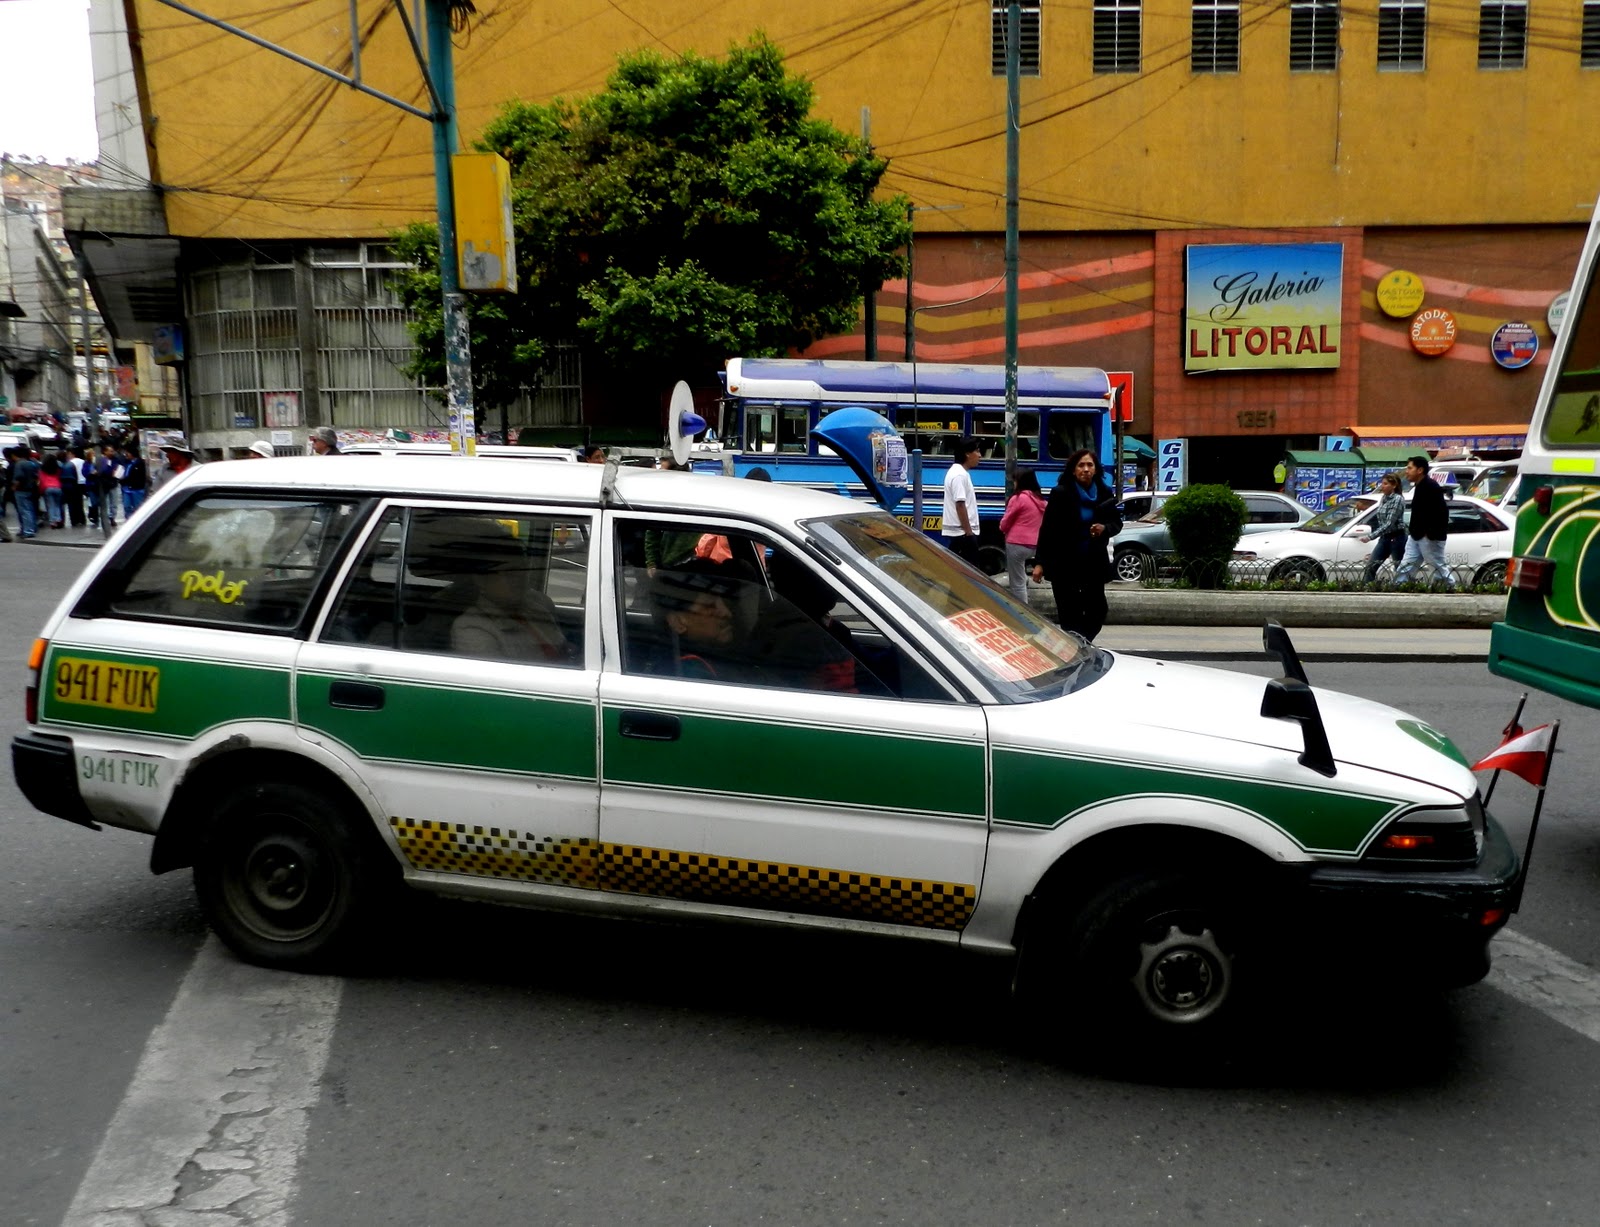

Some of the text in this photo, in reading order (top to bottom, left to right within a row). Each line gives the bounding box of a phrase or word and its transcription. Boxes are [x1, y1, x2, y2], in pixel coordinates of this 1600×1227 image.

[1209, 271, 1324, 323] Galeria
[1411, 308, 1455, 338] ORTODENT
[1190, 324, 1337, 358] LITORAL
[1236, 409, 1277, 428] 1351
[1299, 495, 1319, 508] tigo
[56, 662, 159, 708] 941 FUK
[82, 755, 160, 788] 941 FUK
